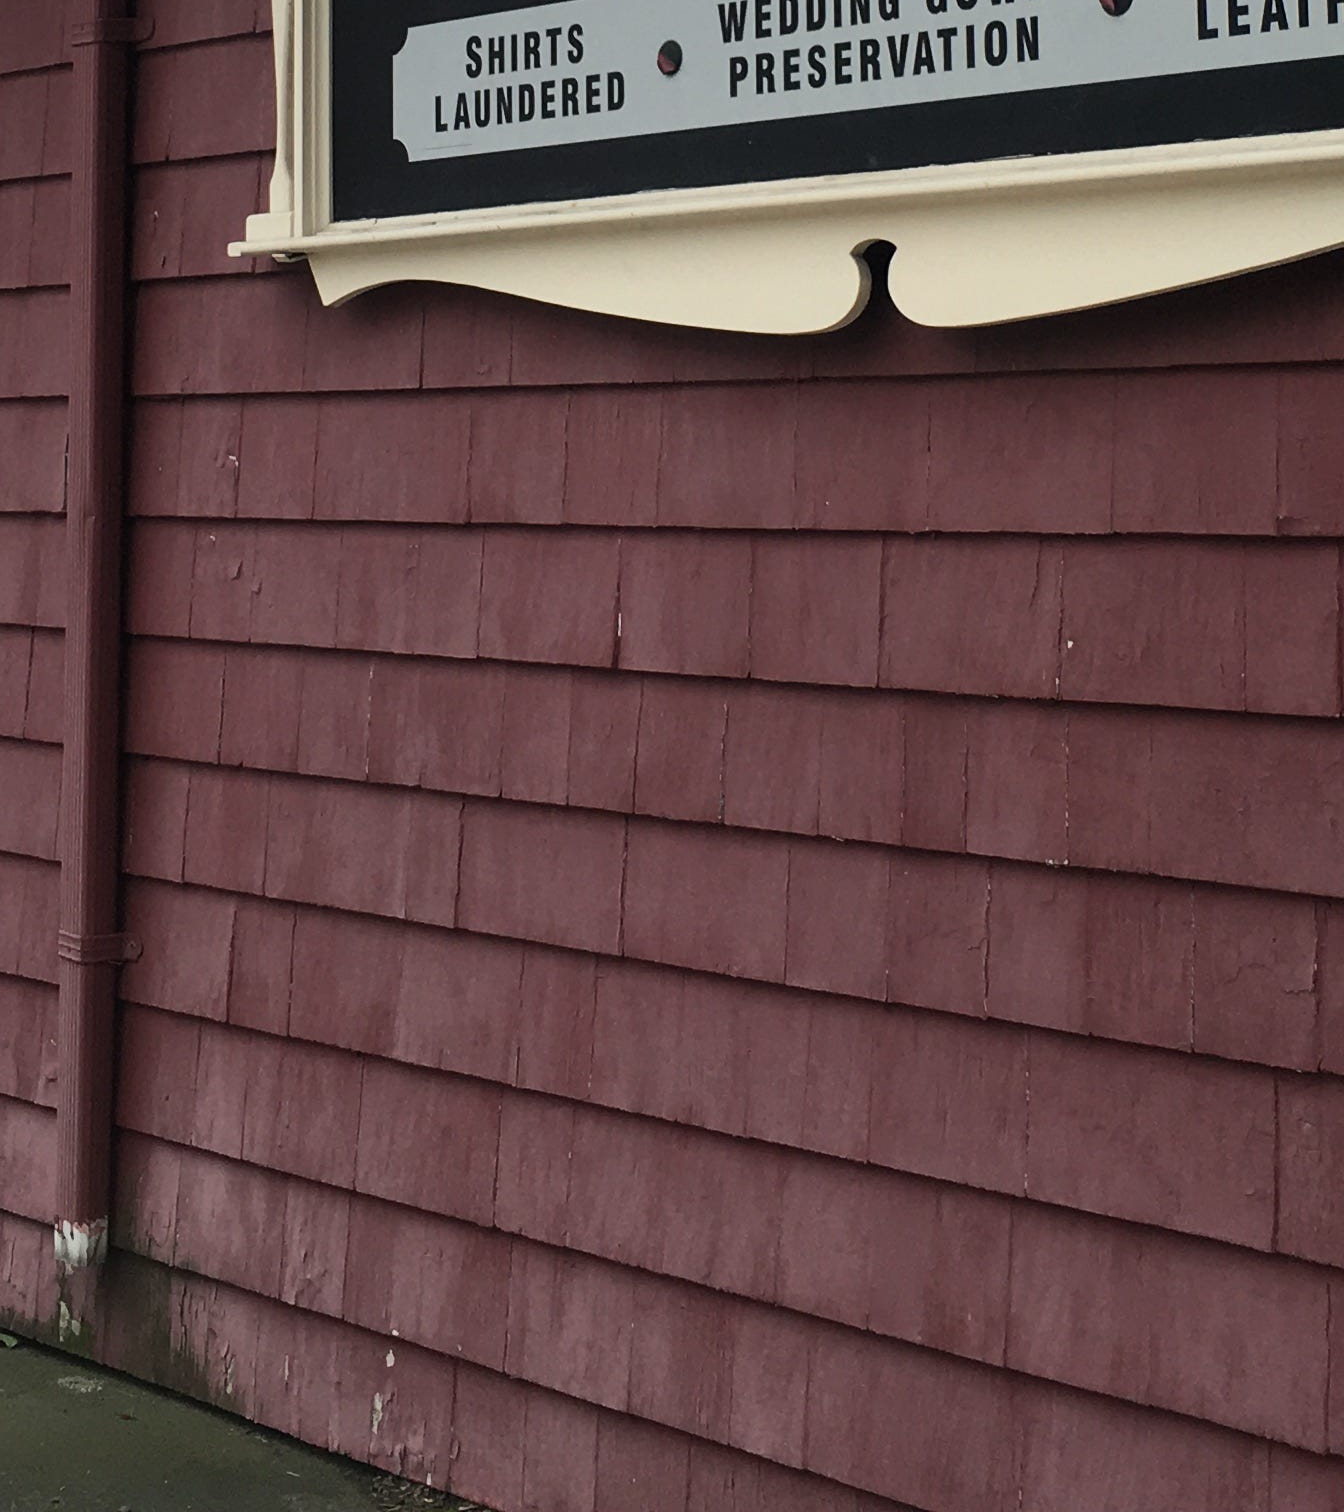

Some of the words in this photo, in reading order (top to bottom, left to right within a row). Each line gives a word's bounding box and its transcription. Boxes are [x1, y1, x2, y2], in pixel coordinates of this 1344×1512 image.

[464, 24, 585, 79] SHIRTS
[728, 15, 1041, 98] PRESERVATION
[433, 71, 627, 133] LAUNDERED
